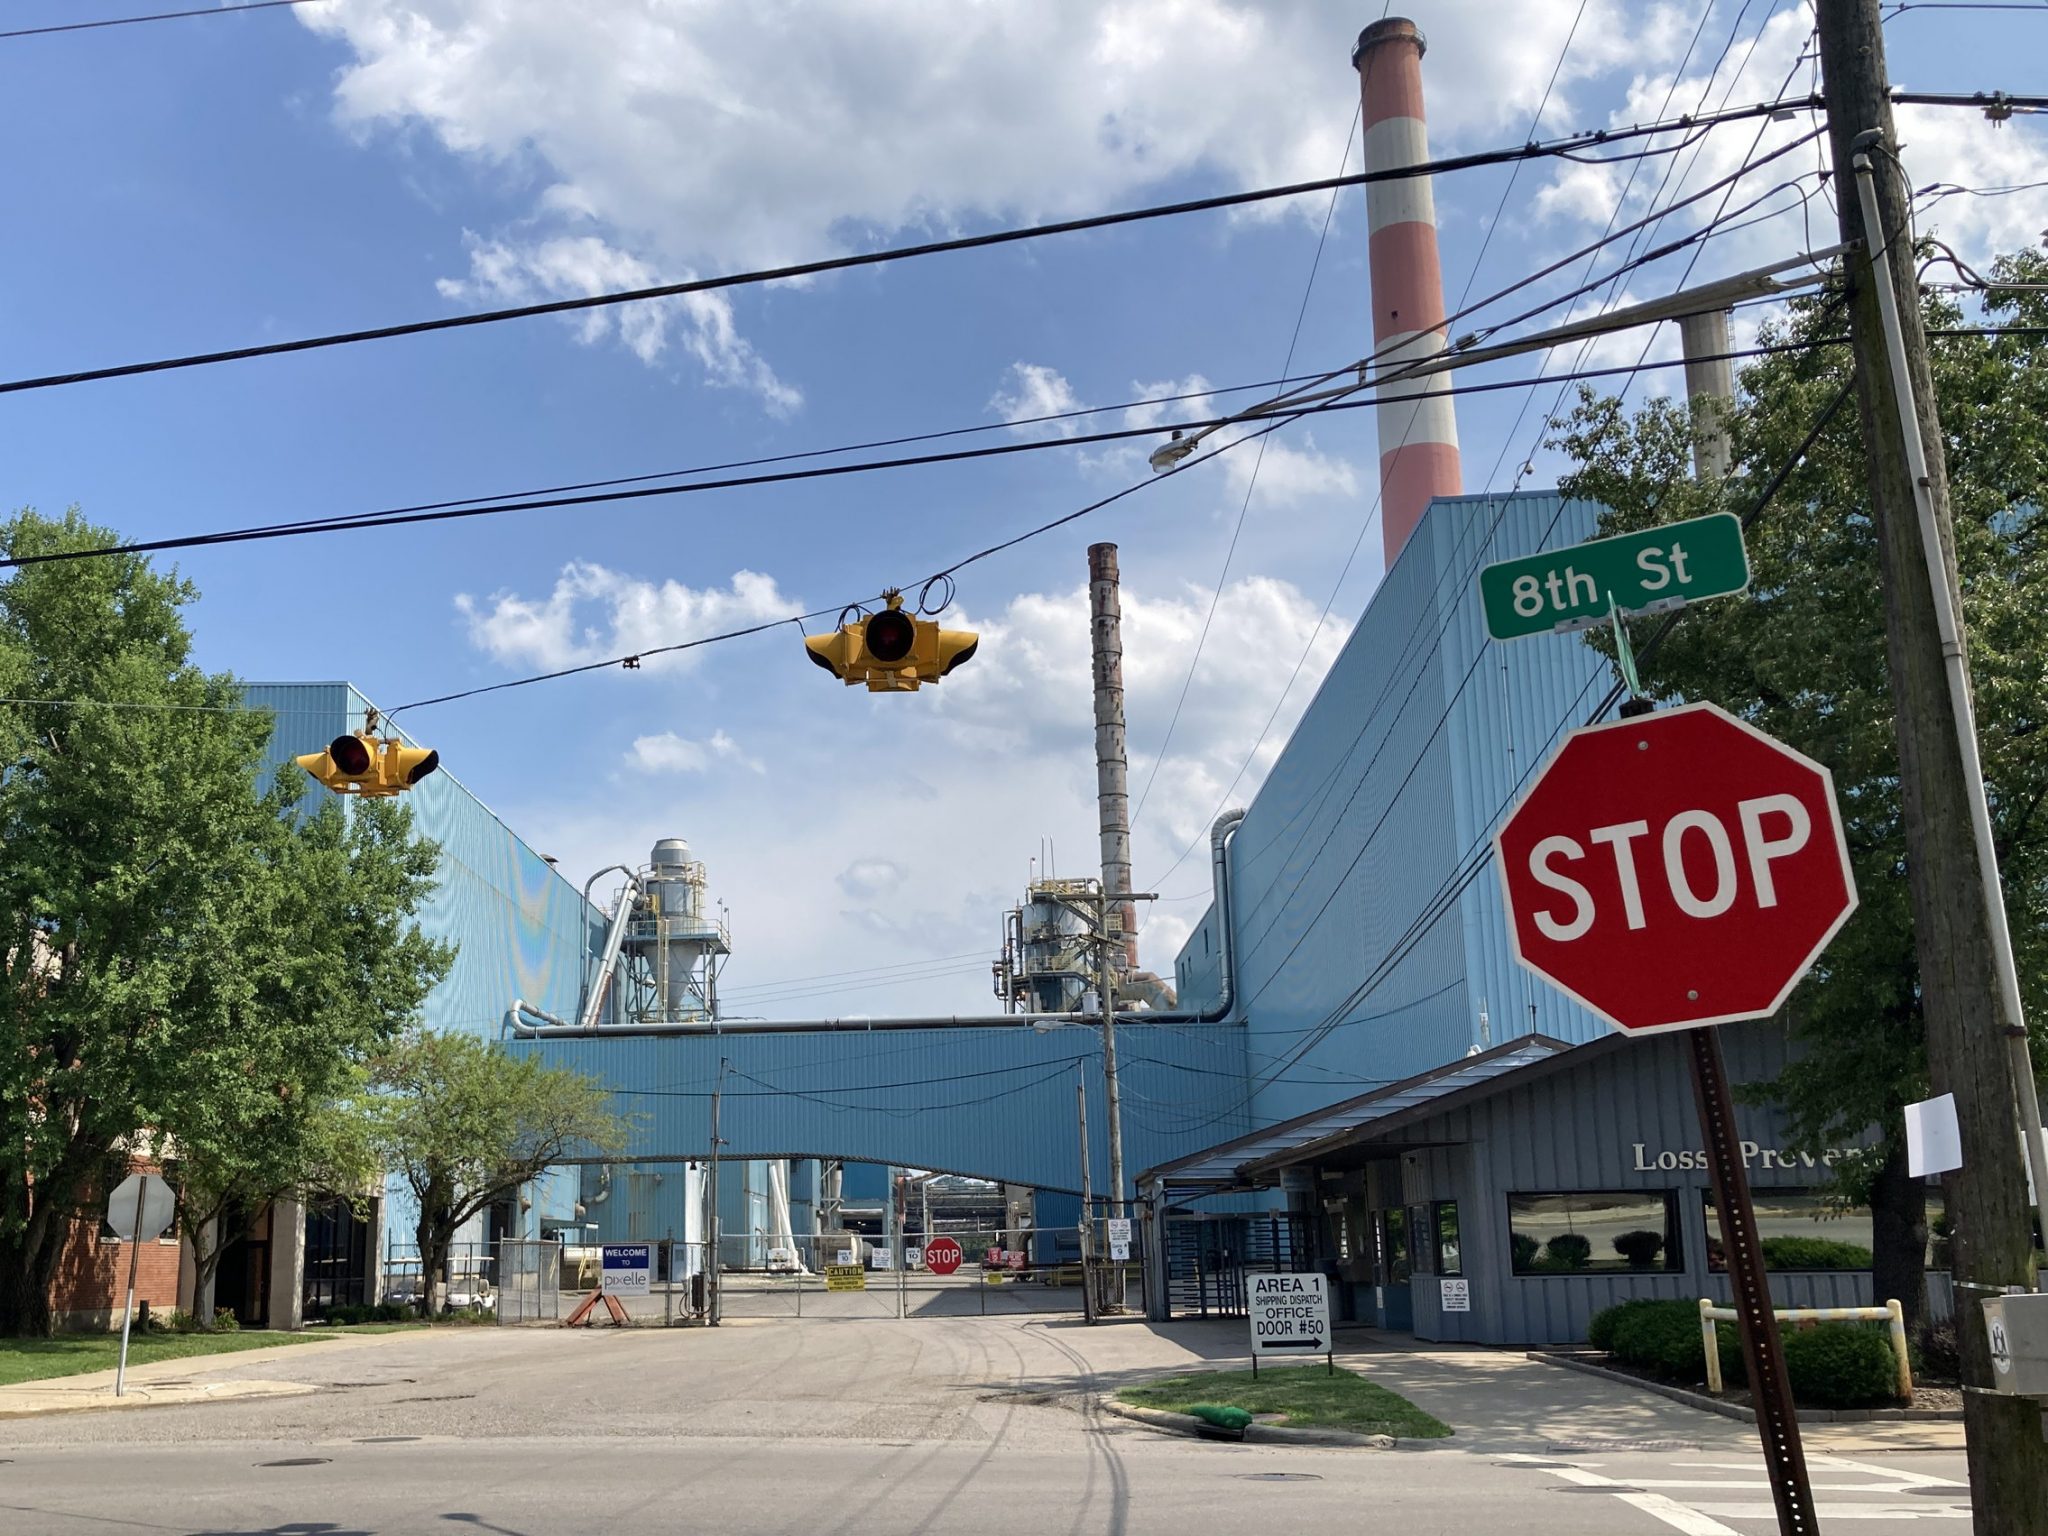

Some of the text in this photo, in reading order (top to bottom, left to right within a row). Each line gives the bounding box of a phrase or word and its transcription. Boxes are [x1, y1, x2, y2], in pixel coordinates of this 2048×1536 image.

[1511, 541, 1693, 618] 8th St
[1528, 792, 1812, 943] STOP
[1632, 1143, 1709, 1171] Loss
[605, 1248, 647, 1257] WELCOME
[927, 1248, 960, 1264] STOP
[829, 1267, 863, 1276] CAUTION
[604, 1271, 647, 1290] pixelle
[1255, 1277, 1320, 1293] AREA 1
[1255, 1294, 1323, 1306] SHIPPING DISPATCH
[1265, 1306, 1315, 1319] OFFICE
[1256, 1319, 1324, 1336] DOOR #50
